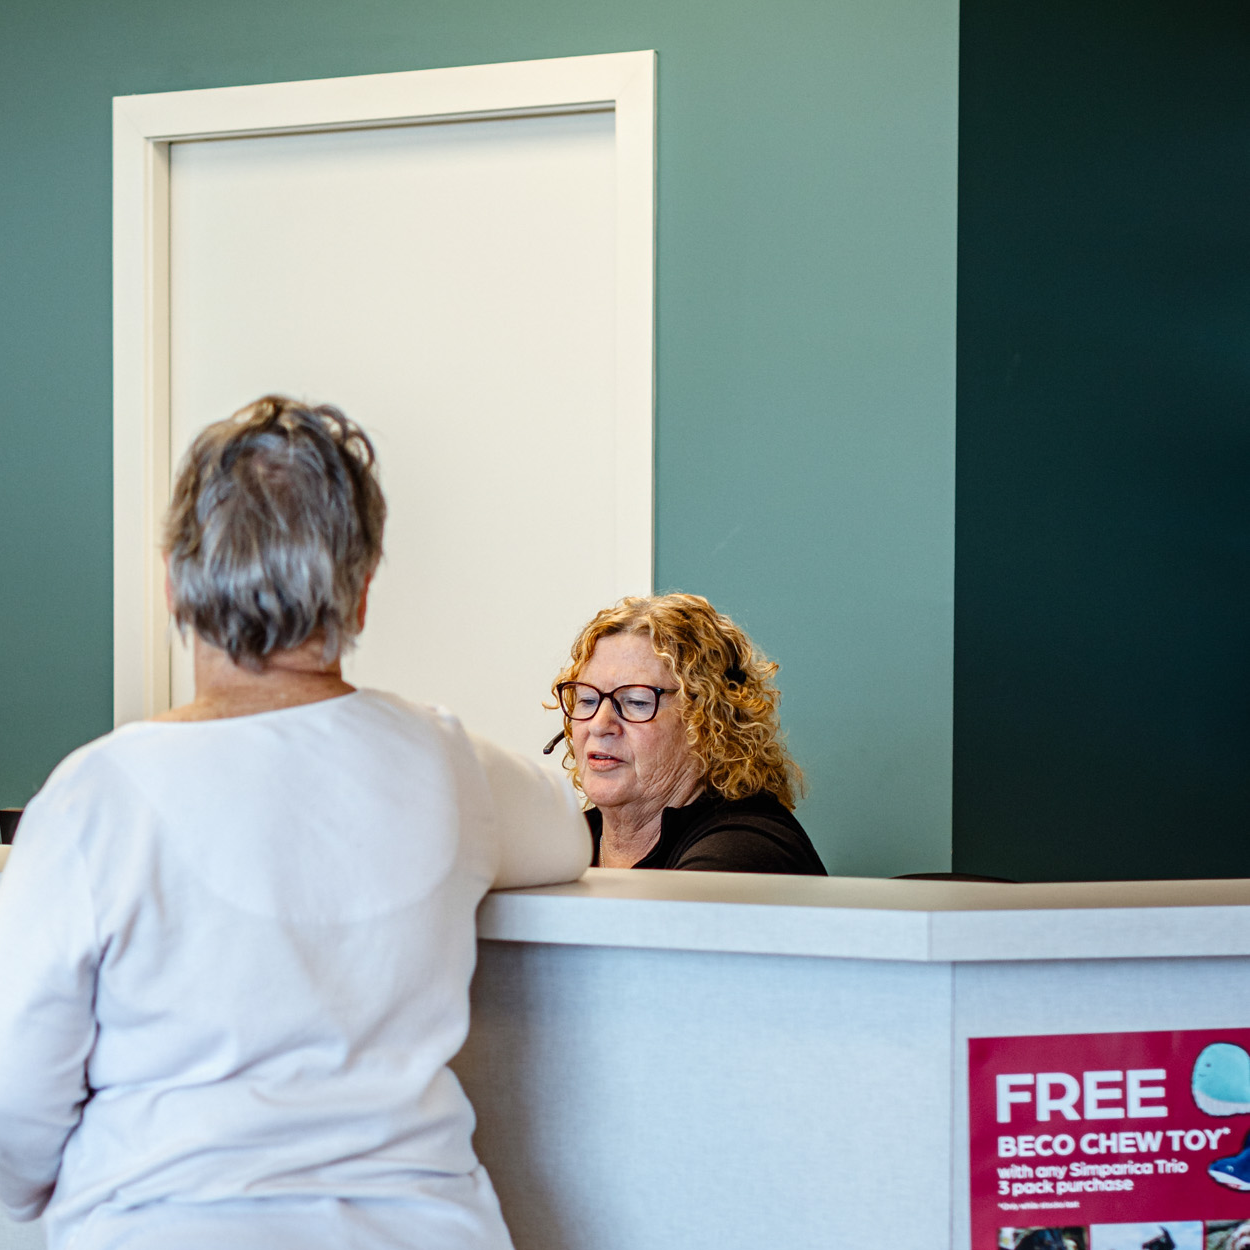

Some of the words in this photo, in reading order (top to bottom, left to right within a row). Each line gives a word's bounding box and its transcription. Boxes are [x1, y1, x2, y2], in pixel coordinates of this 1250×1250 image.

[996, 1068, 1168, 1123] FREE
[997, 1134, 1075, 1158] BECO
[1080, 1131, 1163, 1153] CHEW
[997, 1164, 1033, 1179] with
[1035, 1166, 1067, 1180] any
[1069, 1161, 1154, 1178] Simparica
[1154, 1158, 1189, 1174] Trio
[998, 1181, 1010, 1195] 3
[1012, 1179, 1054, 1197] pack
[1056, 1178, 1134, 1195] purchase
